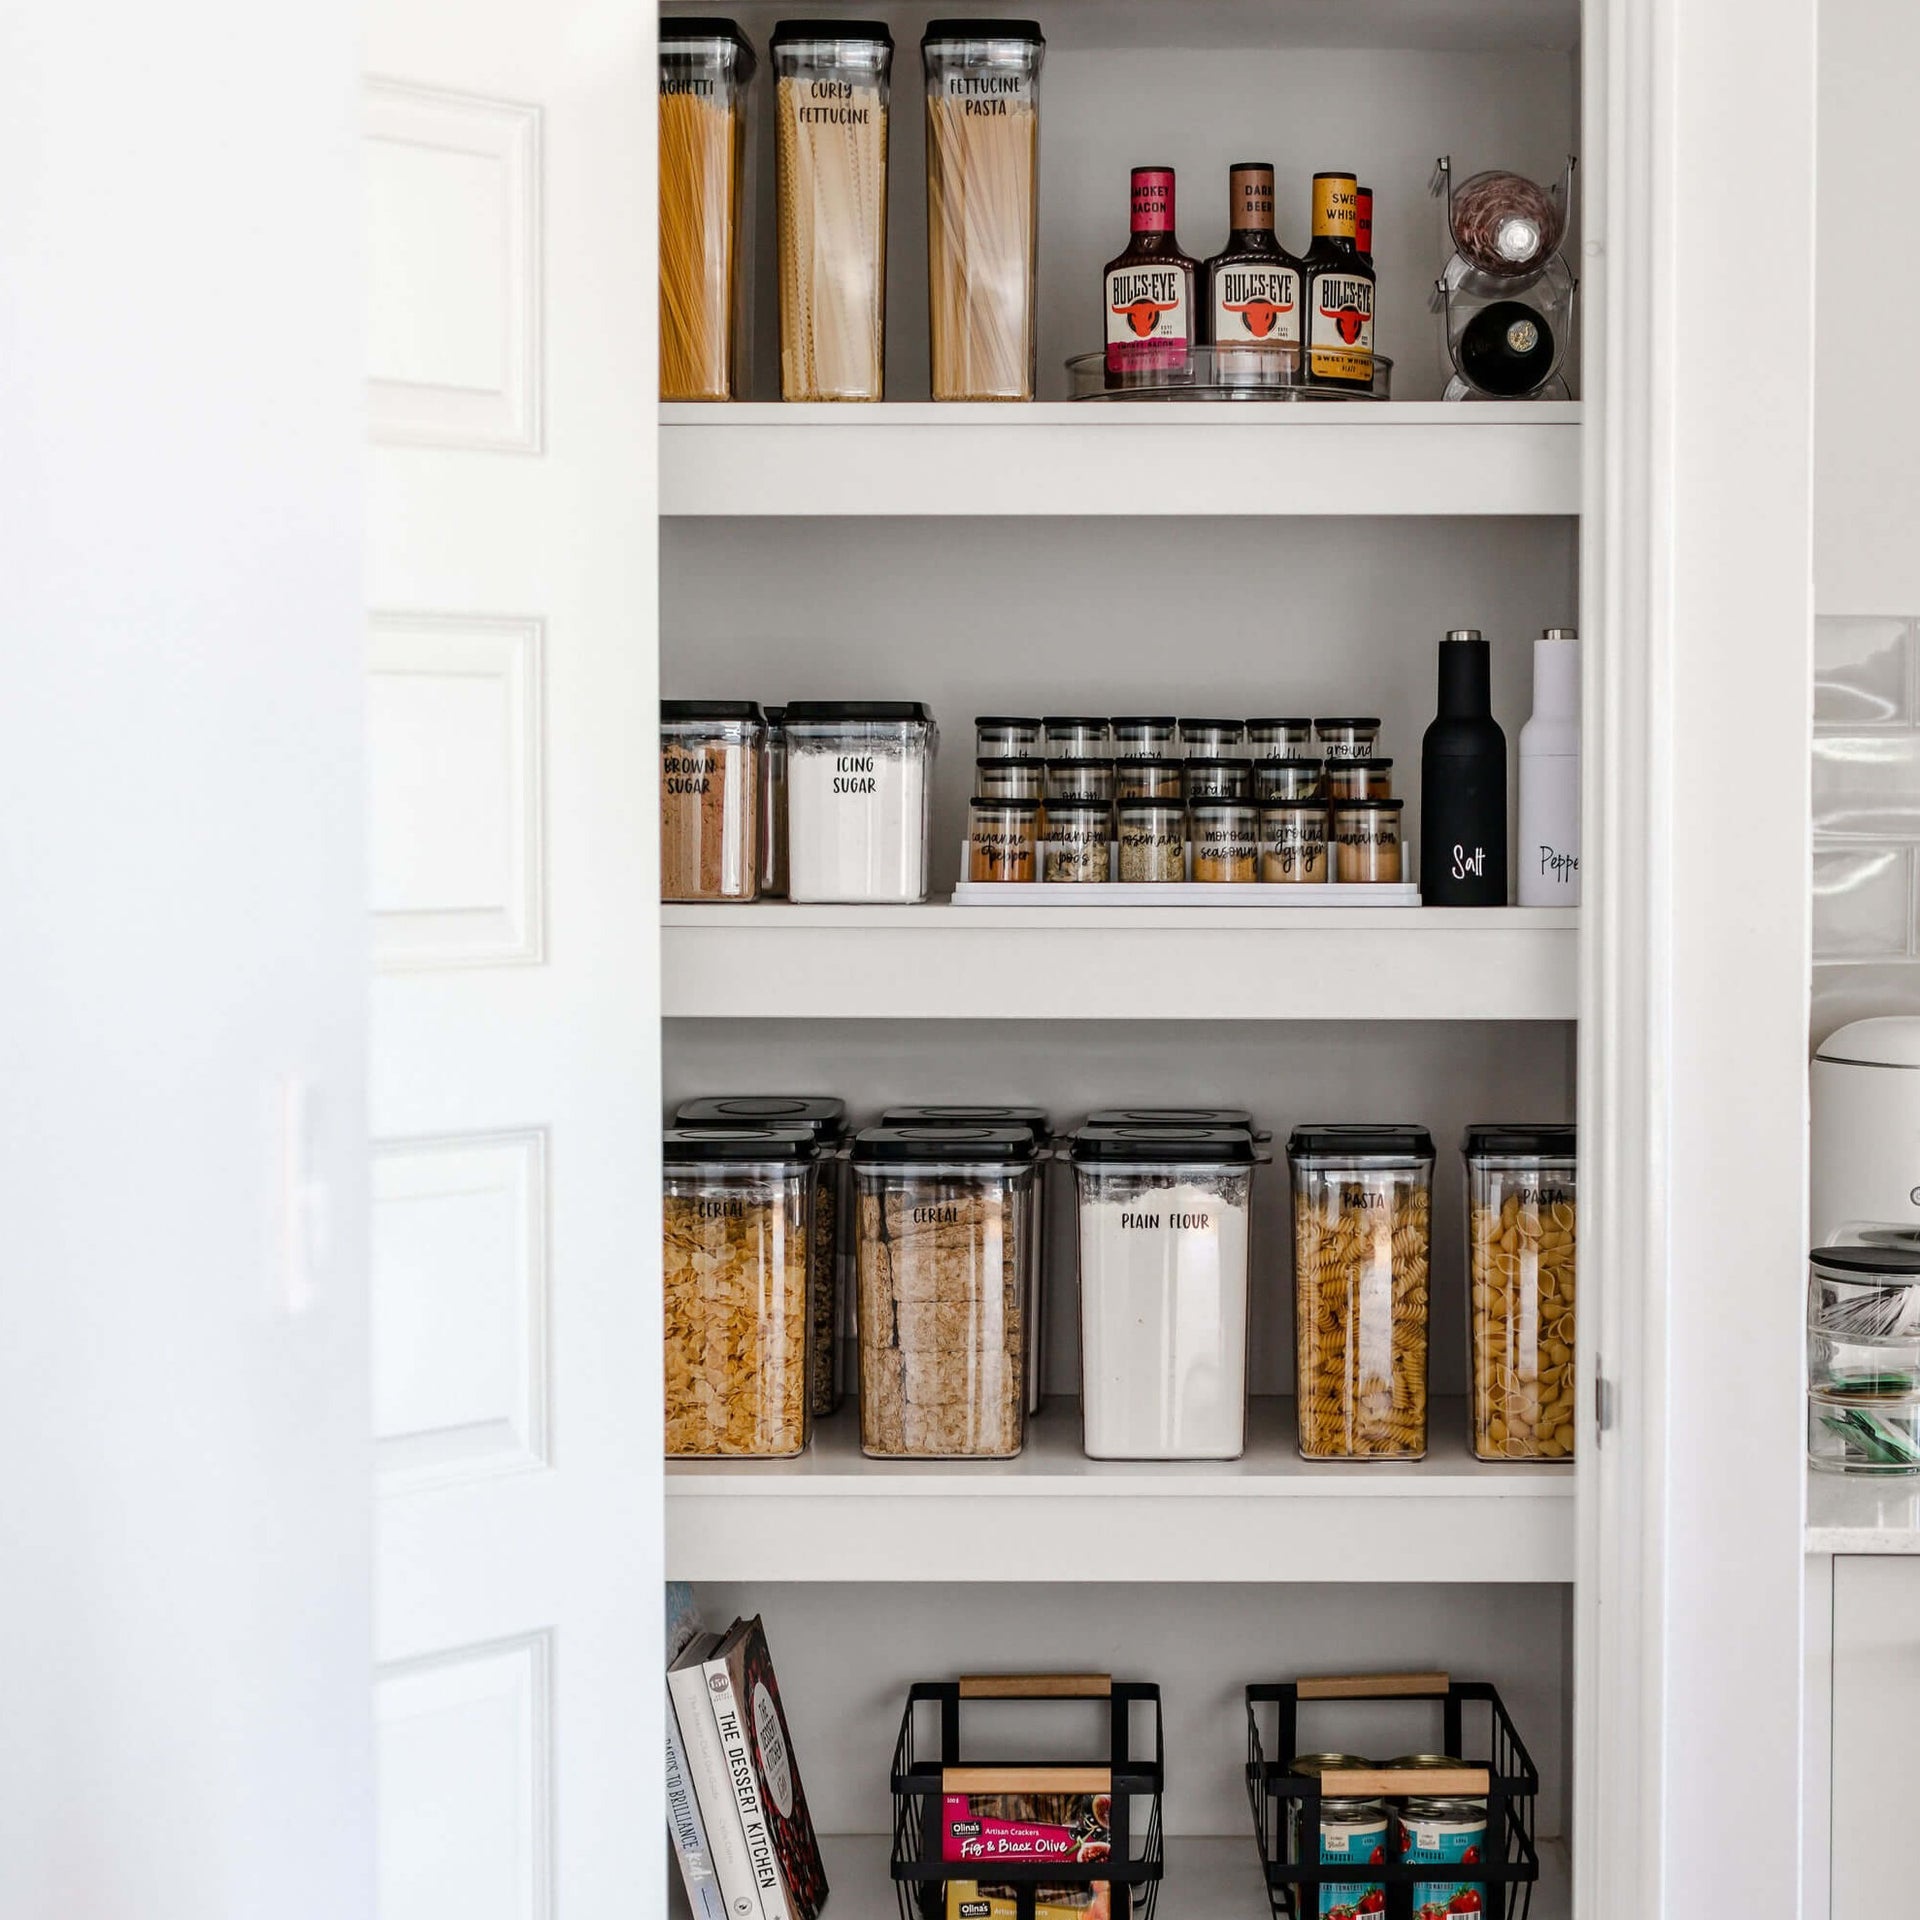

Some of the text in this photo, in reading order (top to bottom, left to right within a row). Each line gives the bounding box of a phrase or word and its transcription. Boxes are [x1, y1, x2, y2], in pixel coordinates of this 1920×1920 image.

[811, 81, 853, 99] CURLY
[950, 77, 1020, 94] FETTUCINE
[800, 107, 869, 124] FETTUCINE
[965, 99, 1006, 116] PASTA
[1247, 201, 1272, 212] BEER
[664, 757, 715, 774] BROWN
[837, 757, 874, 772] ICING
[667, 778, 710, 793] SUGAR
[833, 777, 877, 793] SUGAR
[1451, 844, 1486, 880] Salt
[1343, 1192, 1385, 1209] PASTA
[1523, 1188, 1564, 1206] PASTA
[699, 1201, 743, 1218] CEREAL
[913, 1207, 959, 1223] CEREAL
[1121, 1212, 1210, 1229] PLAIN FLOUR
[719, 1710, 740, 1742] THE
[665, 1774, 682, 1789] TO
[728, 1747, 758, 1814] DESSERT
[668, 1787, 699, 1850] BRILLIANCE
[953, 1823, 980, 1833] Olina's
[985, 1828, 1009, 1836] Artisan
[1010, 1828, 1040, 1836] Crackers
[746, 1822, 776, 1889] KITCHEN
[960, 1837, 1069, 1859] Fig & Black Olive
[961, 1903, 989, 1914] Olina's
